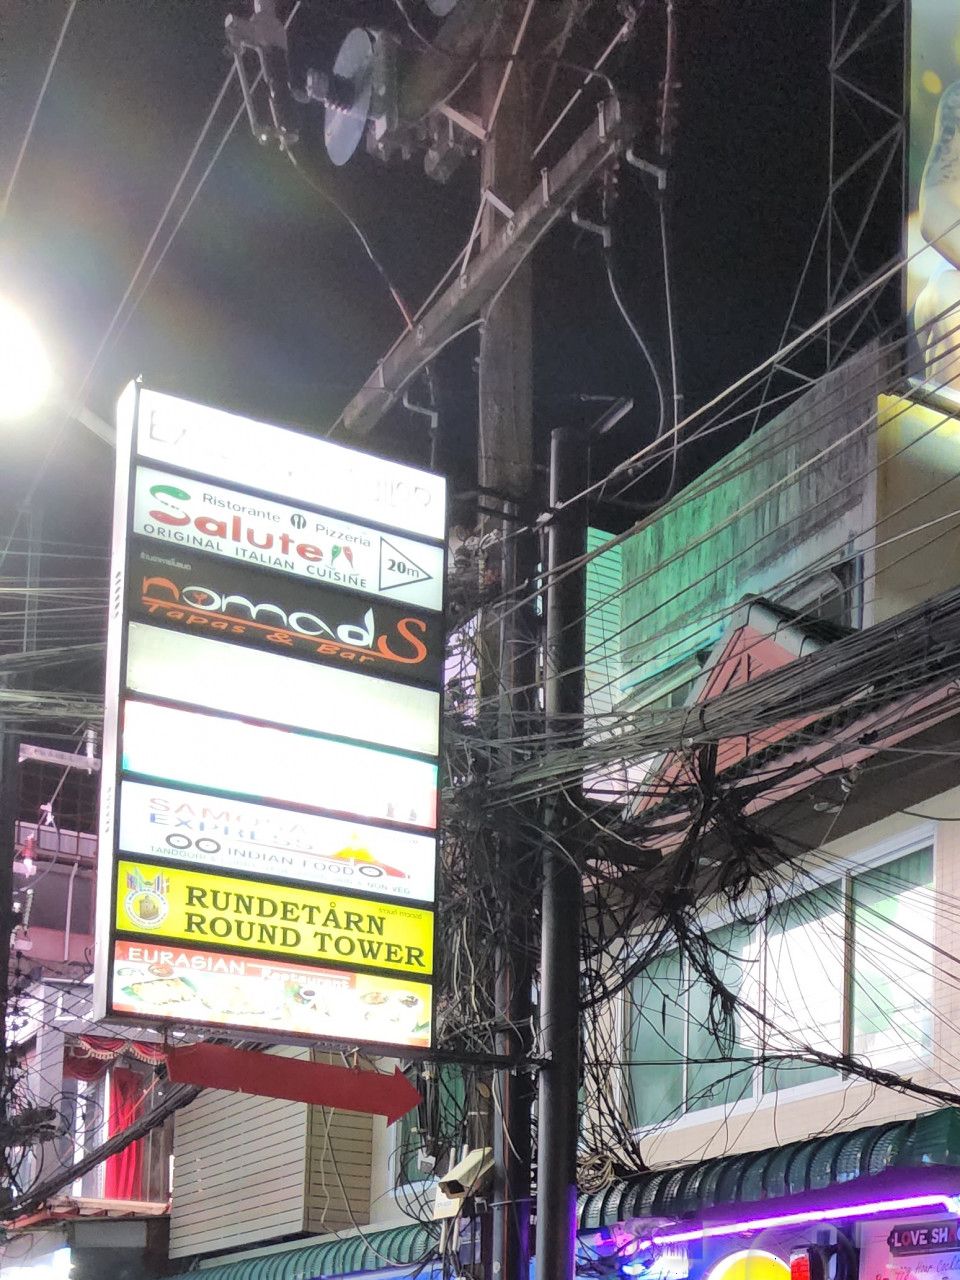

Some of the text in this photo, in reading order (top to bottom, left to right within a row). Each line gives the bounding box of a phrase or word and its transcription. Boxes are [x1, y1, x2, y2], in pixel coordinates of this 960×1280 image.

[149, 484, 324, 562] Salute
[202, 492, 371, 548] Ristorante Pizzeria
[143, 523, 367, 589] ORIGINAL ITALIAN CUISINE
[387, 559, 420, 579] 20m
[145, 601, 375, 664] Tapas & Bar
[228, 847, 293, 866] INDIAN
[185, 886, 386, 936] RUNDETÅRN
[128, 947, 246, 976] EURASIAN
[184, 912, 426, 967] ROUND TOWER
[894, 1229, 928, 1247] LOVE
